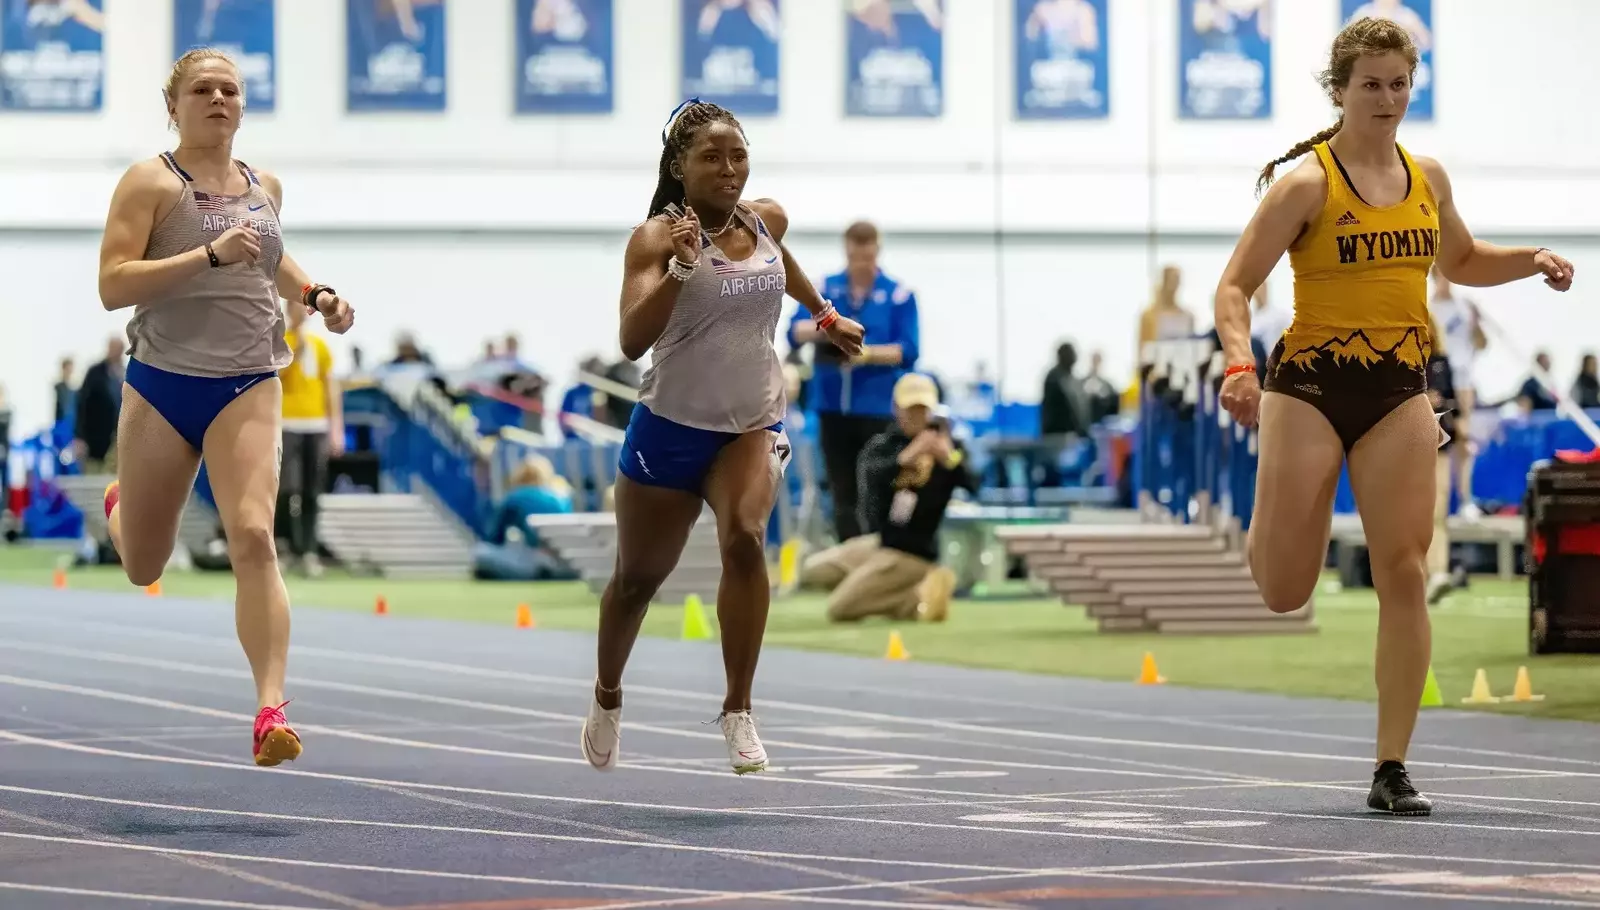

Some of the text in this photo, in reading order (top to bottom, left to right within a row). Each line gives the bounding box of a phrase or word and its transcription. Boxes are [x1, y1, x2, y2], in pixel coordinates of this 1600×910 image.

[202, 214, 226, 231] AIR
[1336, 229, 1438, 264] WYOMIN
[720, 272, 786, 297] AIR FORC
